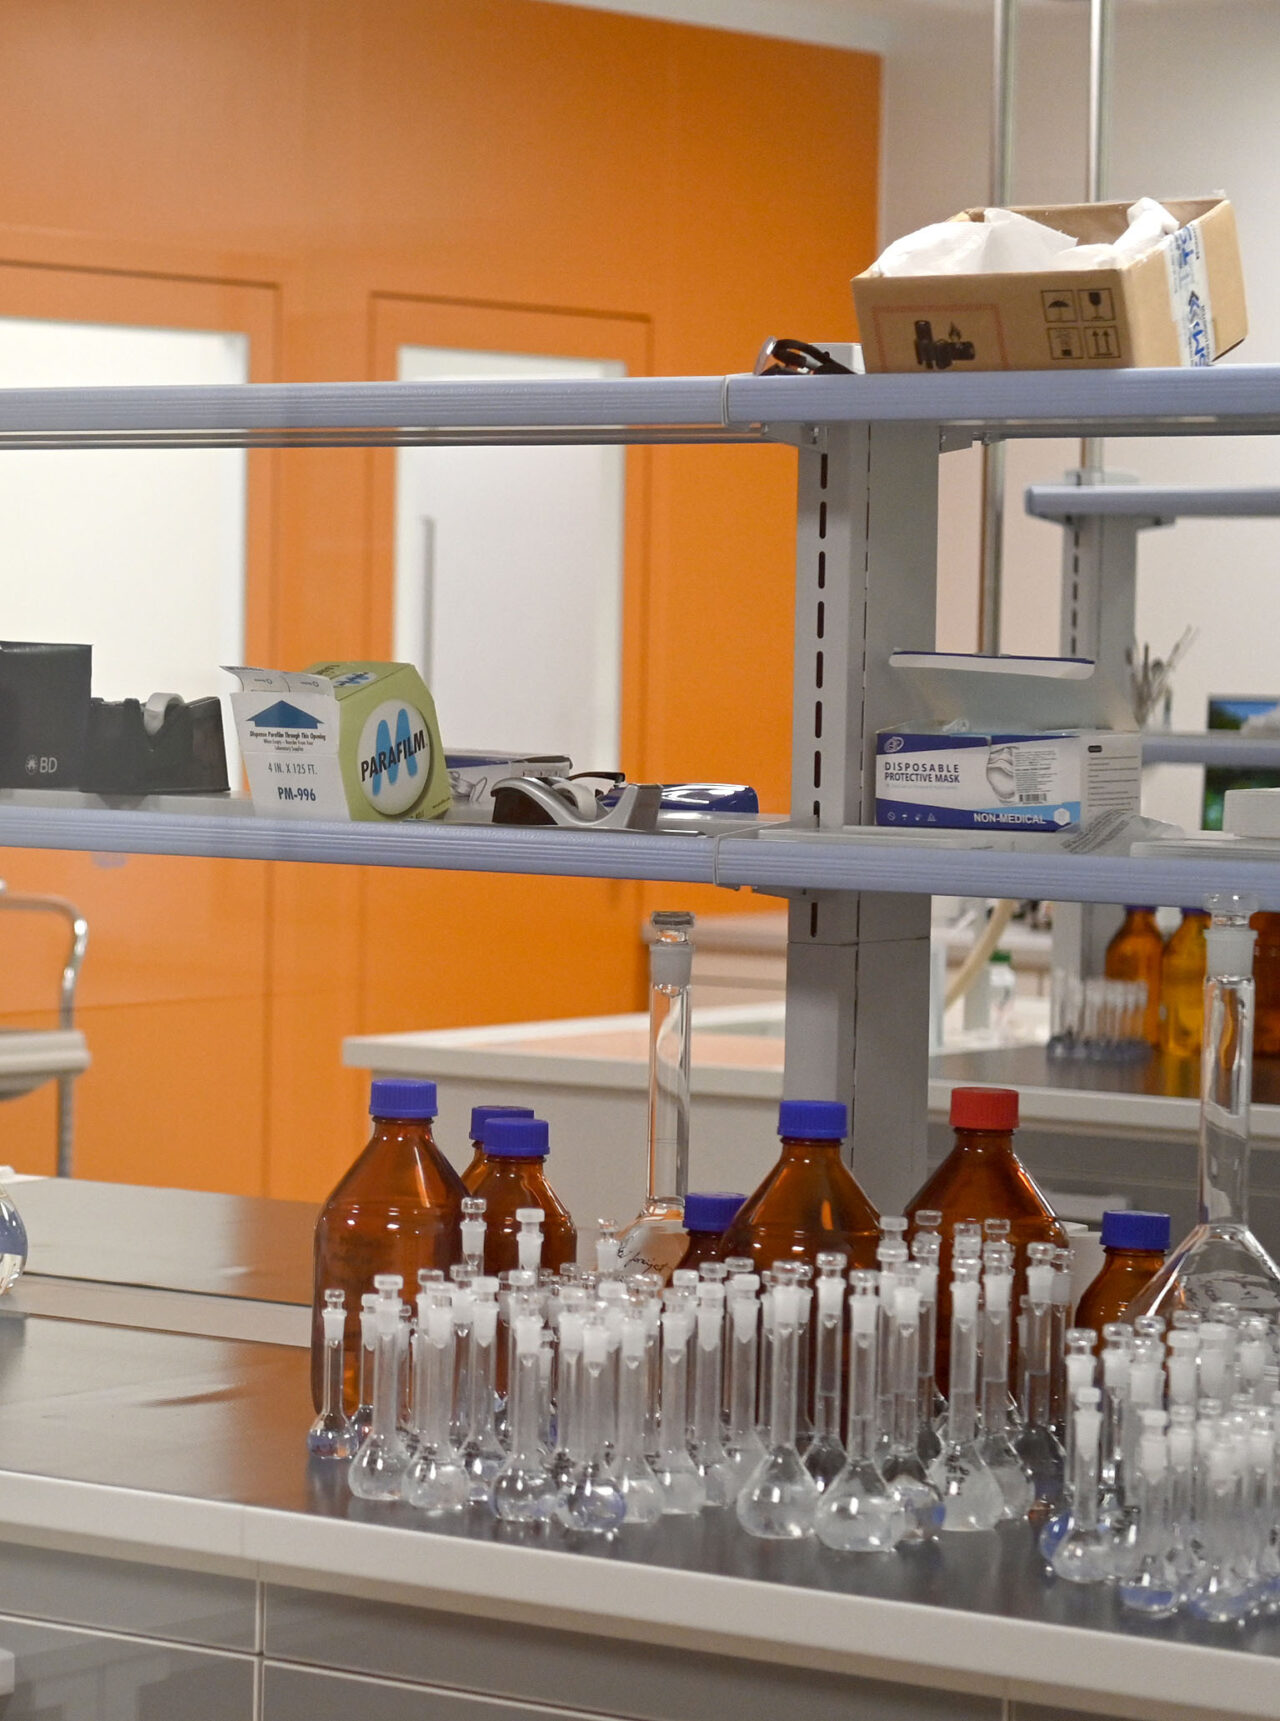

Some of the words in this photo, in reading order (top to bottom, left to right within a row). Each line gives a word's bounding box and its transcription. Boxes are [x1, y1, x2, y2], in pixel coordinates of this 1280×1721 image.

[361, 729, 426, 782] PARAFILM
[39, 756, 58, 773] BD
[267, 762, 273, 773] 4
[274, 762, 285, 774] IN.
[285, 763, 292, 774] X
[292, 763, 306, 775] 125
[307, 763, 318, 775] FT.
[884, 761, 960, 774] DISPOSABLE
[884, 771, 933, 783] PROTECTIVE
[934, 773, 960, 784] MASK
[277, 786, 317, 802] PM-996
[973, 812, 1047, 825] NON-MEDICAL
